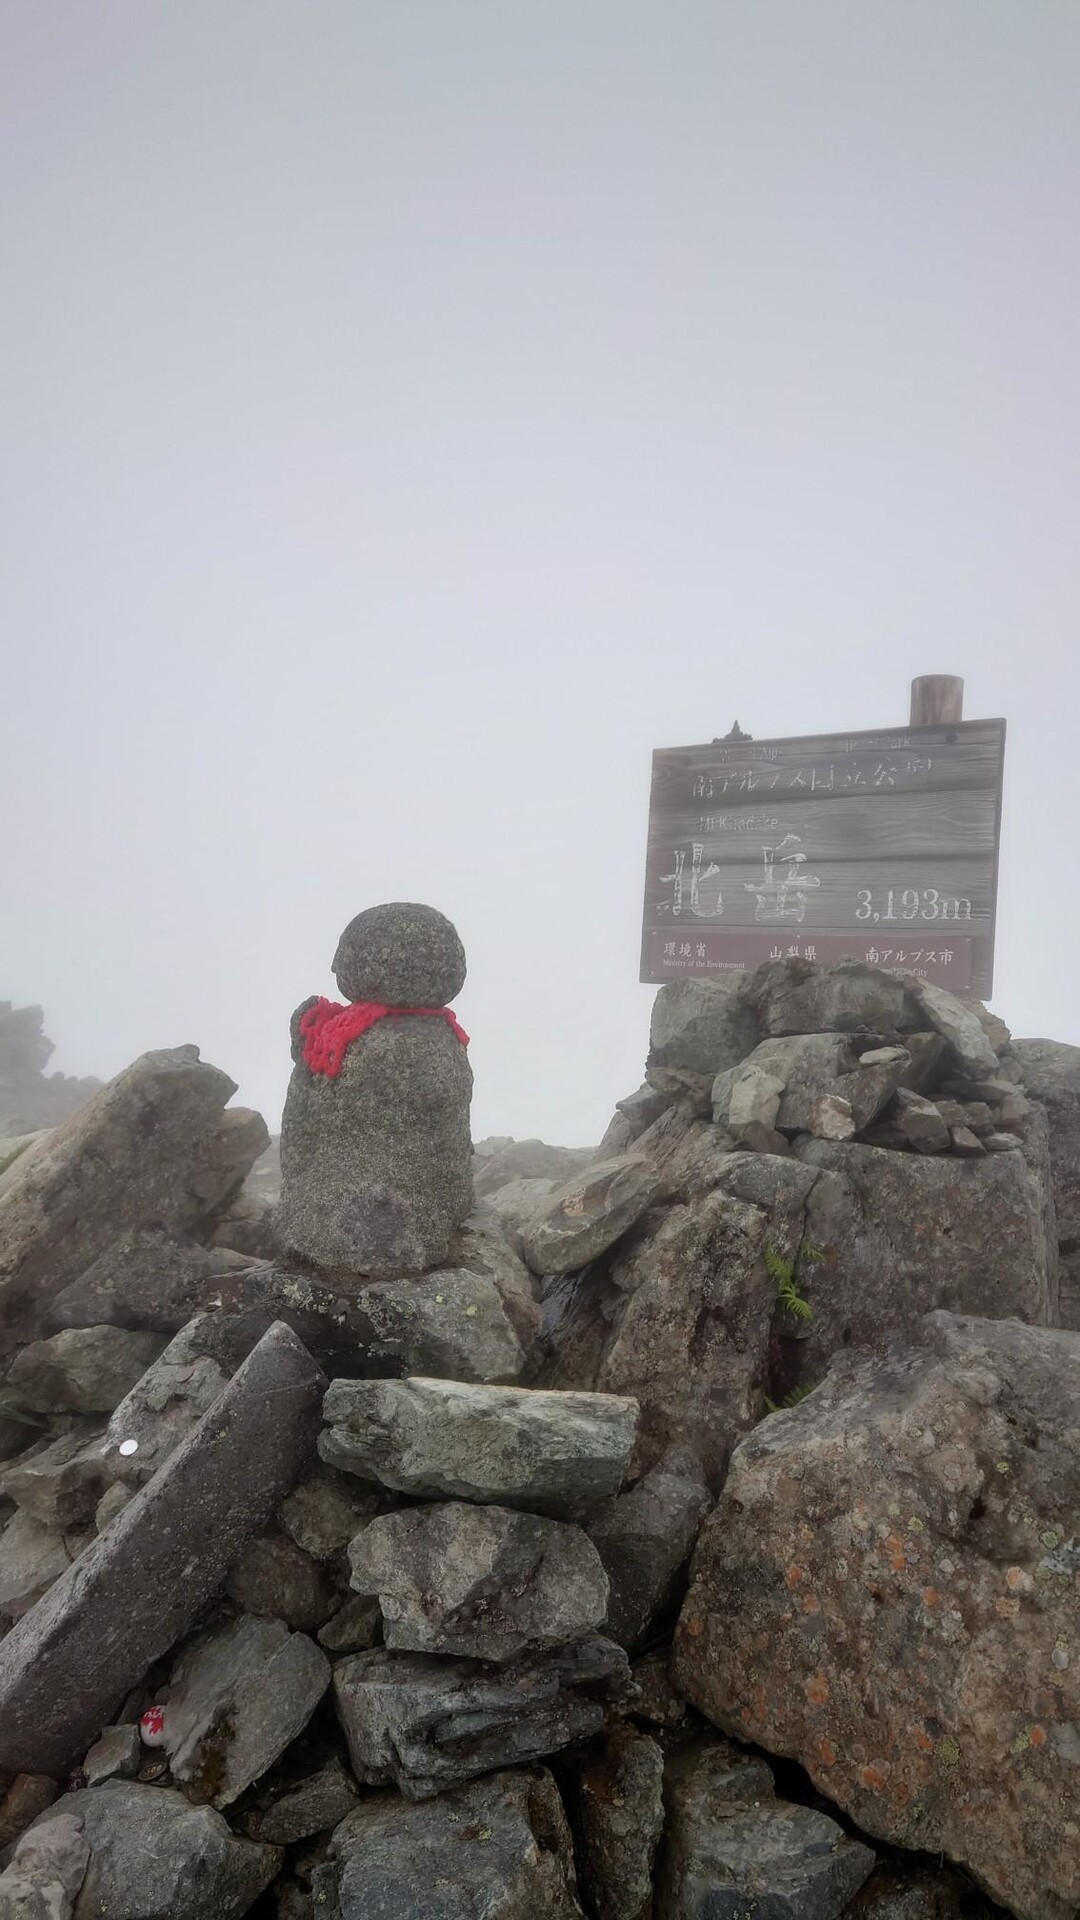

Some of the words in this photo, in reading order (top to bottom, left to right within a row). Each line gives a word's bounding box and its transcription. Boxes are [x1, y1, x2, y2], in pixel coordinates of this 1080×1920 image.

[854, 887, 973, 923] 3,193m
[663, 942, 707, 958] 環境省
[865, 946, 955, 966] 南アルプス市
[662, 958, 686, 968] Ministry
[688, 959, 695, 968] of
[696, 959, 706, 968] the
[707, 960, 745, 970] Environment
